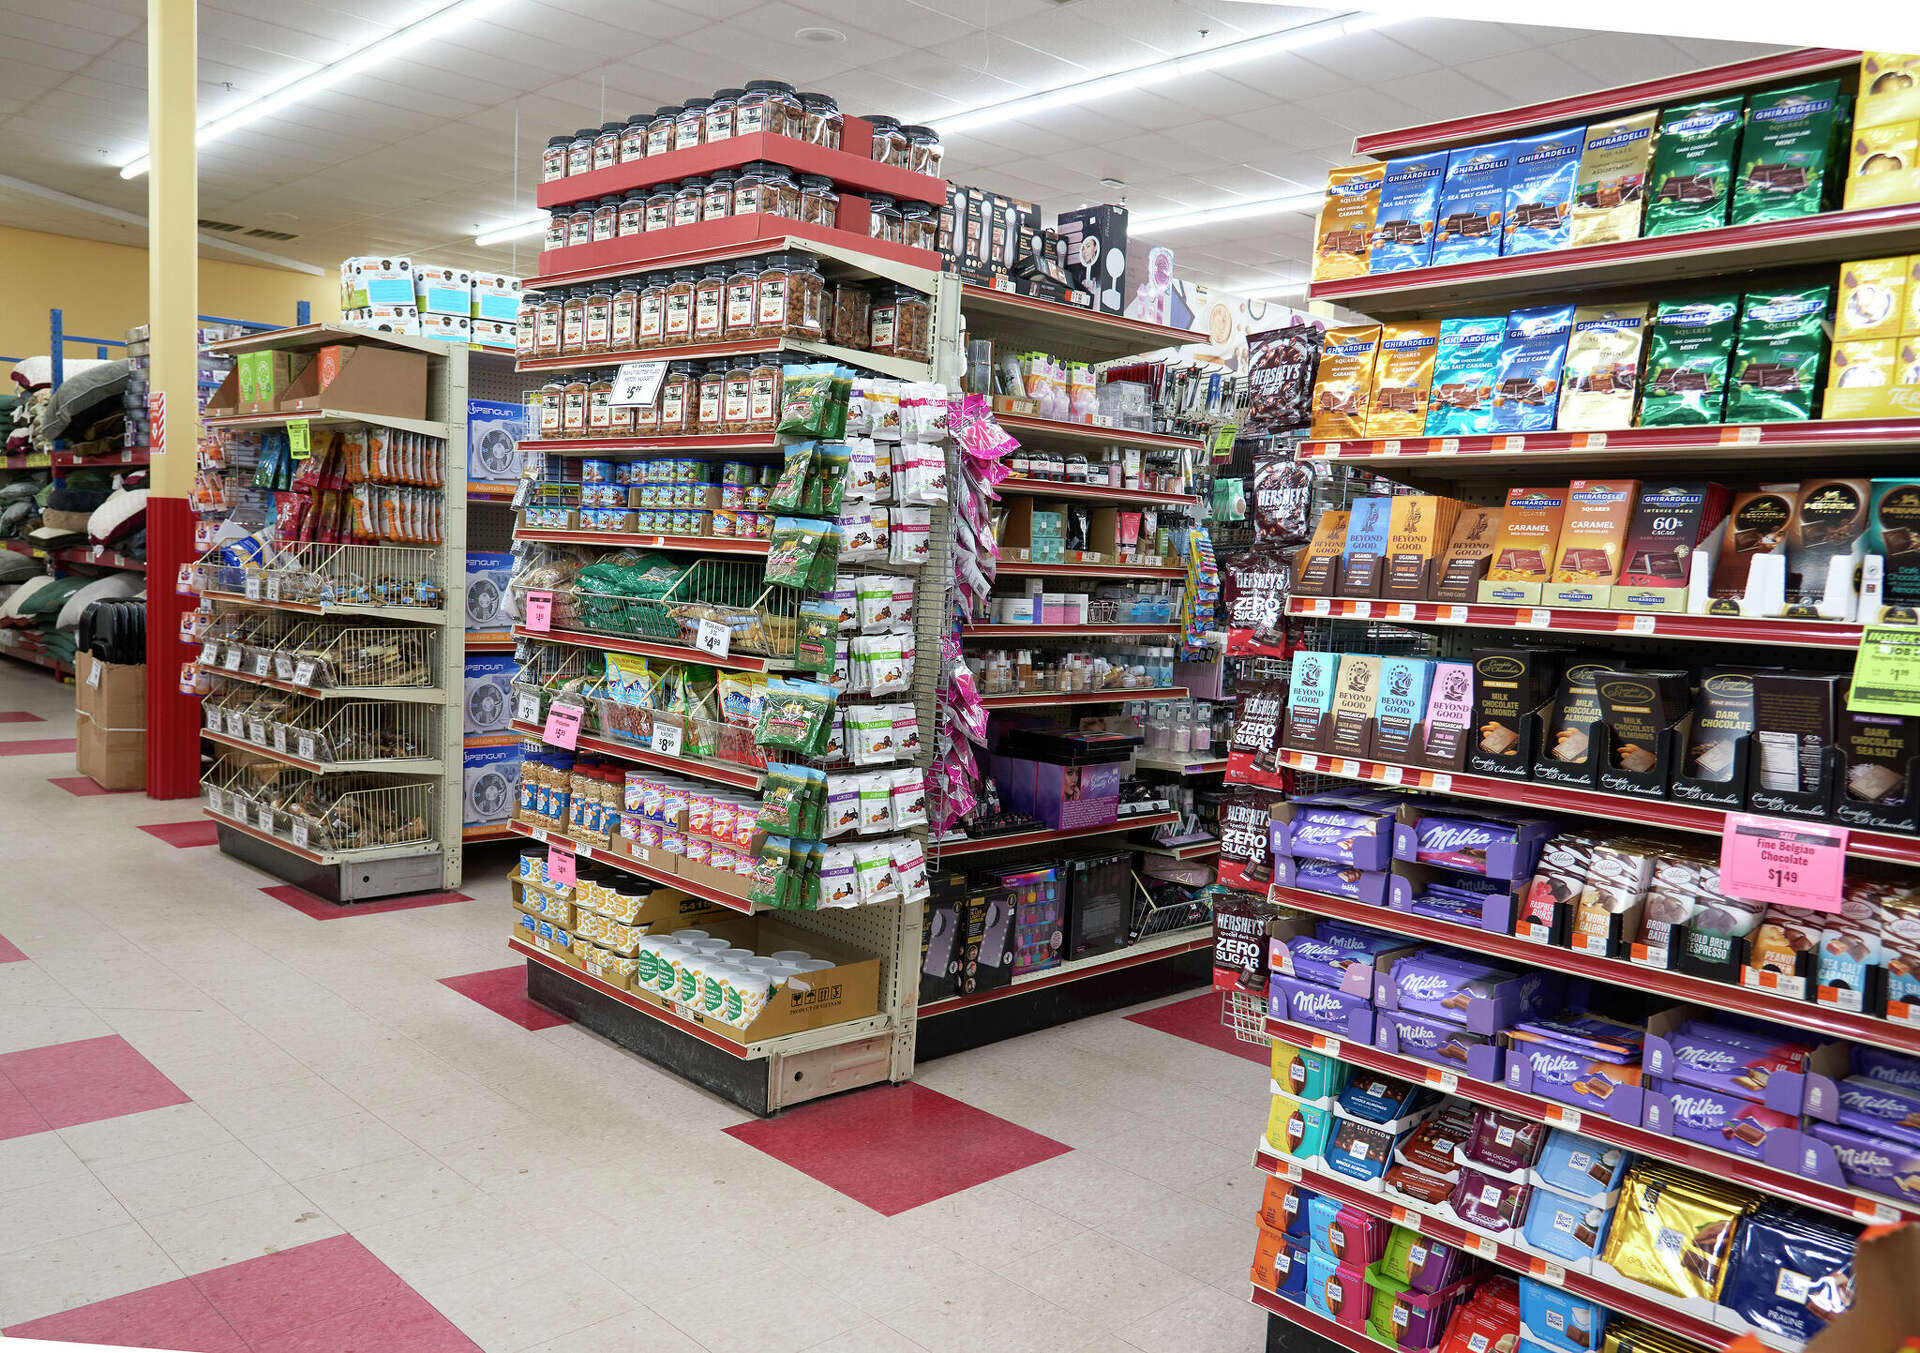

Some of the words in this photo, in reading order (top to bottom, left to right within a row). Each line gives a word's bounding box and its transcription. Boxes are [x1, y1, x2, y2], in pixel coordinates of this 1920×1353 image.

[1590, 130, 1648, 148] GHIRARDELLI
[1519, 147, 1575, 164] GHIRARDELLI
[1454, 160, 1508, 174] GHIRARDELLI
[1388, 169, 1439, 183] GHIRARDELLI
[1475, 189, 1502, 197] CARAMEL
[1577, 319, 1640, 332] GHIRARDELLI
[1385, 338, 1434, 348] GHIRARDELLI
[1680, 343, 1699, 351] MINT
[1252, 364, 1300, 386] HERSHEY'S
[1258, 487, 1308, 506] HERSHEY'S
[1573, 493, 1625, 501] GHIRARDELLI
[1644, 495, 1701, 503] GHIRARDELLI
[1571, 521, 1615, 529] CARAMEL
[1234, 597, 1280, 611] ZERO
[1293, 688, 1324, 697] BEYOND
[1338, 692, 1372, 702] BEYOND
[1296, 696, 1319, 704] GOOD
[1342, 701, 1366, 709] GOOD
[1381, 697, 1415, 708] BEYOND
[1433, 702, 1470, 712] BEYOND
[1482, 700, 1519, 709] CHOCOLATE
[1576, 699, 1593, 707] MILK
[1384, 706, 1410, 714] GOOD
[1436, 710, 1463, 719] GOOD
[1485, 708, 1517, 717] ALMONDS
[1564, 706, 1602, 716] CHOCOLATE
[1715, 710, 1740, 719] DARK
[1564, 714, 1600, 722] ALMONDS
[1702, 719, 1752, 730] CHOCOLATE
[1237, 721, 1276, 738] ZERO
[1864, 728, 1890, 737] DARK
[1235, 734, 1273, 749] SUGAR
[1851, 736, 1905, 748] CHOCOLATE
[1227, 805, 1271, 827] HERSHEY'S
[1222, 828, 1267, 848] ZERO
[1297, 825, 1341, 840] Milka
[1421, 825, 1492, 850] Milka
[1221, 842, 1265, 859] SUGAR
[1757, 838, 1776, 850] Fine
[1779, 841, 1815, 855] Belgian
[1761, 850, 1808, 866] Chocolate
[1457, 878, 1498, 891] Milka
[1217, 913, 1264, 936] HERSHEY'S
[1216, 937, 1260, 957] ZERO
[1329, 935, 1366, 950] Milka
[1690, 933, 1708, 945] COLD
[1709, 936, 1731, 950] BREW
[1297, 942, 1339, 956] Milka
[1690, 943, 1727, 960] ESPRESSO
[1215, 950, 1259, 968] SUGAR
[1765, 952, 1795, 963] PEANUT
[1401, 973, 1448, 990] Milka
[1293, 991, 1342, 1012] Milka
[1396, 1023, 1436, 1039] Milka
[1675, 1046, 1737, 1064] Milka
[1530, 1052, 1579, 1073] Milka
[1670, 1094, 1726, 1116] Milka
[1840, 1092, 1908, 1111] Milka
[1357, 1124, 1391, 1140] SELECTION
[1493, 1153, 1517, 1166] CHOCOLATE
[1833, 1144, 1893, 1167] Milka
[1767, 1309, 1804, 1329] PRALINE
